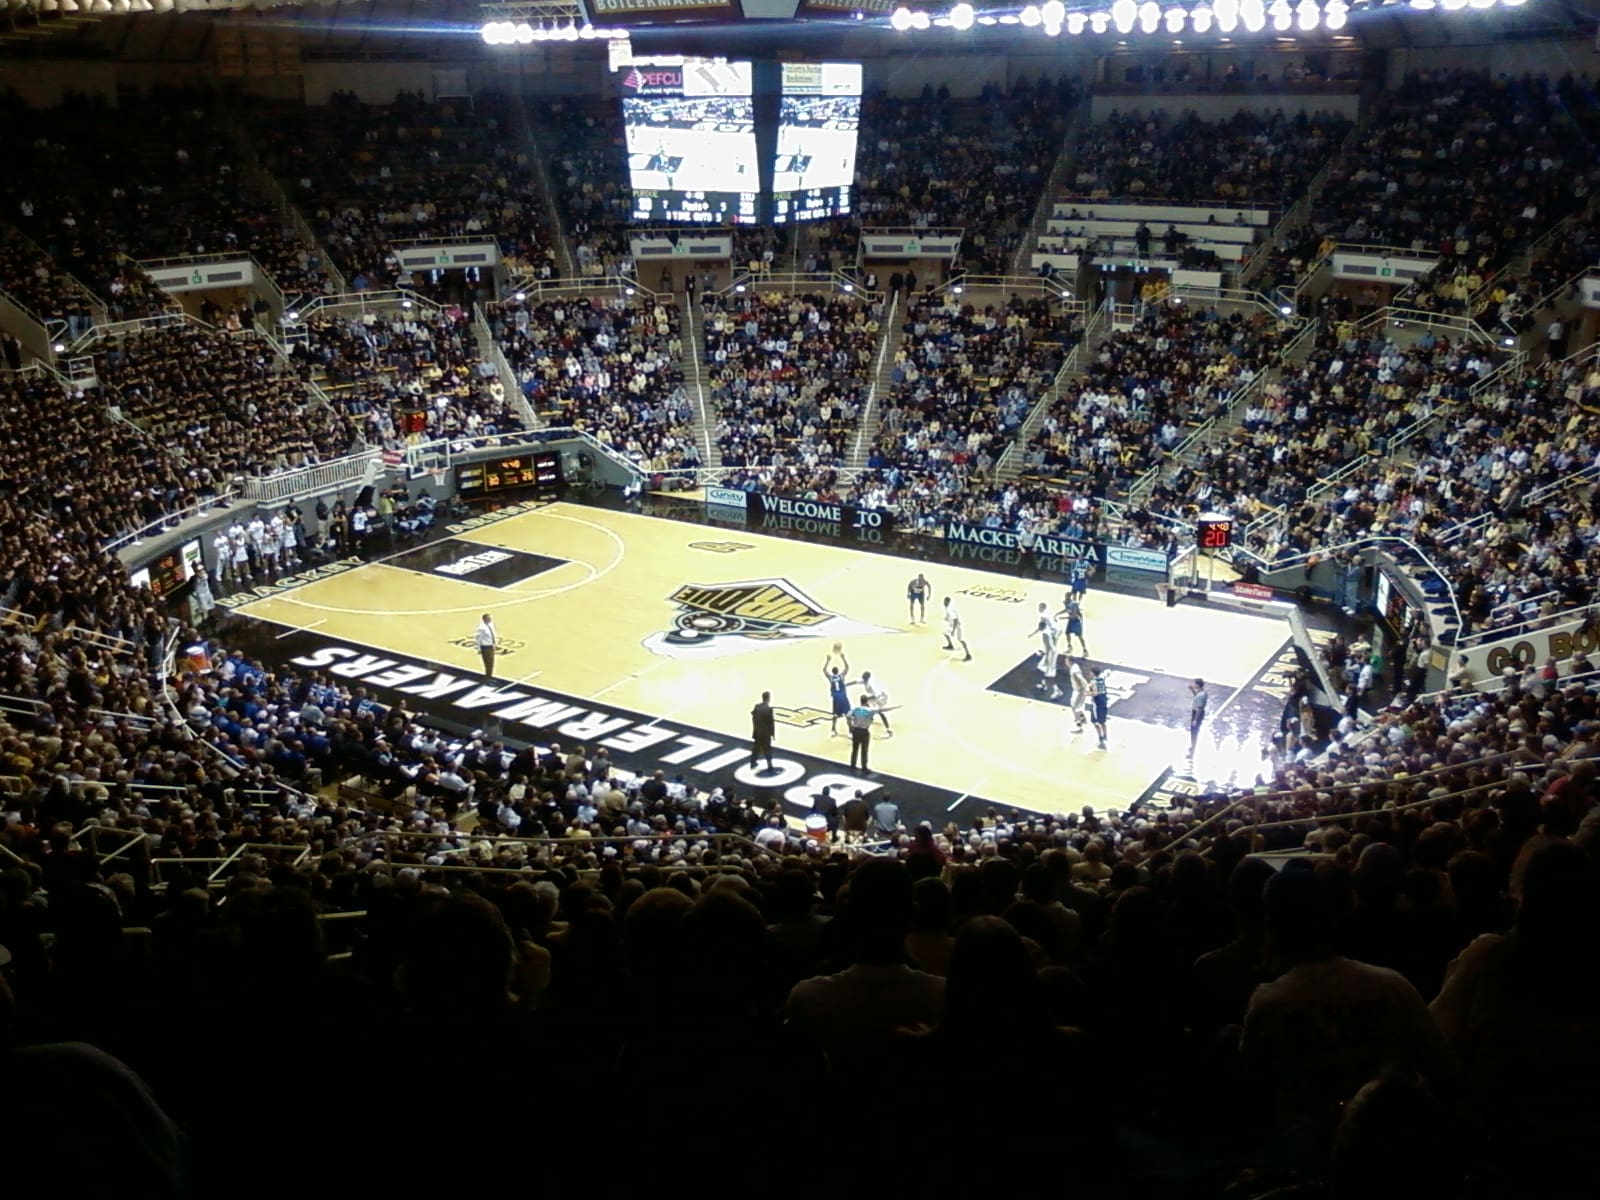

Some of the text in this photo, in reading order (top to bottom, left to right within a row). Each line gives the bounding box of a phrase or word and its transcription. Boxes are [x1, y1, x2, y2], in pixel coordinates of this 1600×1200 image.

[761, 495, 882, 528] WELCOME TO
[948, 523, 1100, 562] MACKEY ARENA
[1204, 531, 1226, 546] 20
[673, 583, 837, 626] PURDUE
[1487, 640, 1536, 677] GO
[290, 647, 885, 808] BOILERMAKERS
